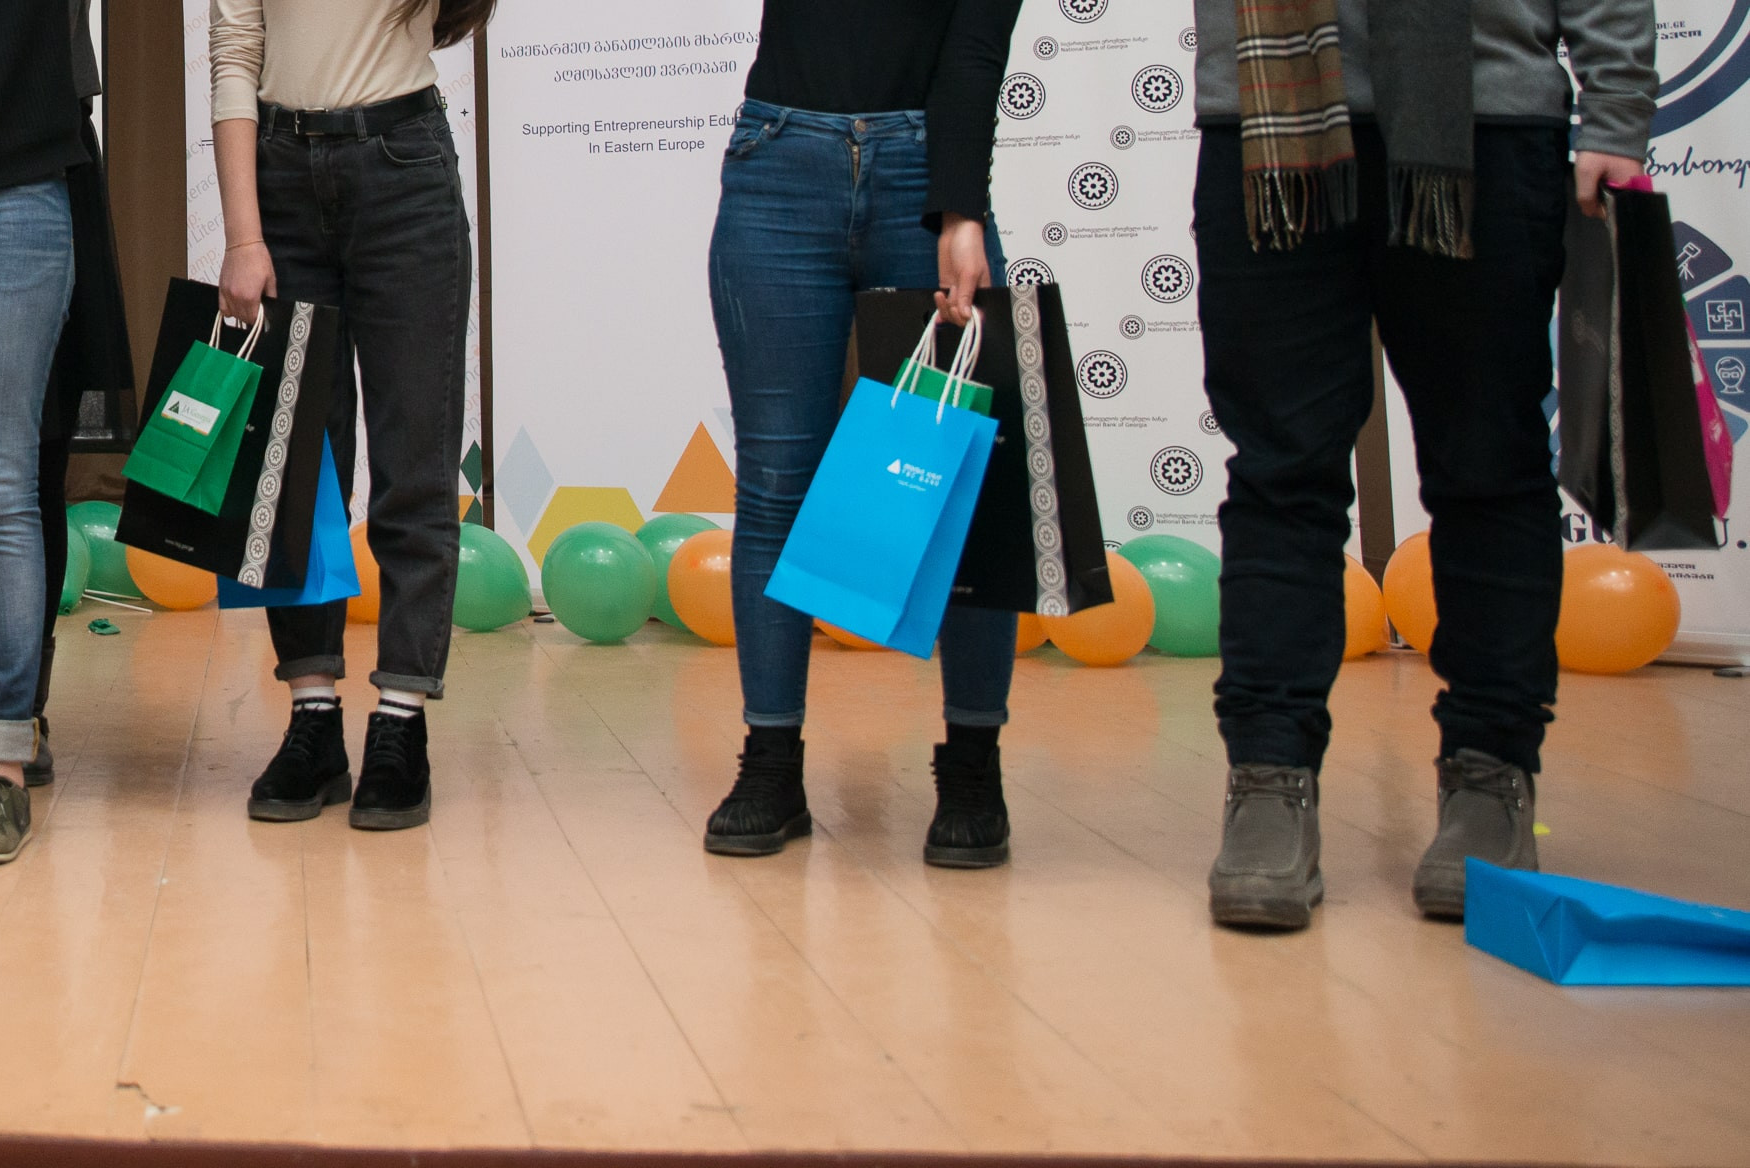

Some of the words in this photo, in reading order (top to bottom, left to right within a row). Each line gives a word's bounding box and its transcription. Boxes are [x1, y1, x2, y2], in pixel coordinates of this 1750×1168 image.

[522, 121, 590, 137] Supporting
[594, 115, 705, 133] Entrepreneurship
[709, 114, 735, 127] Edu
[588, 142, 600, 154] In
[605, 140, 654, 153] Eastern
[658, 138, 705, 155] Europe
